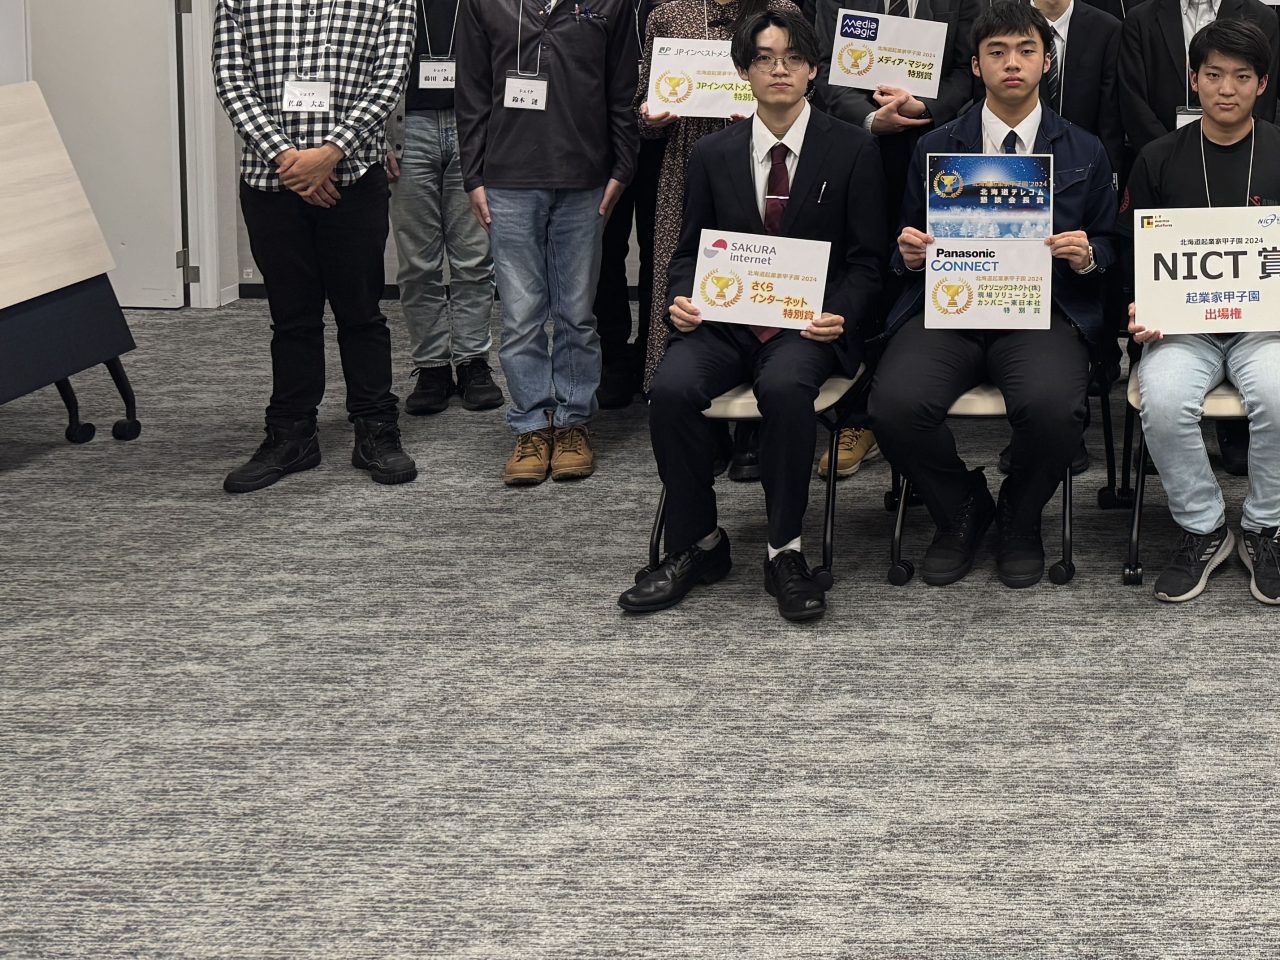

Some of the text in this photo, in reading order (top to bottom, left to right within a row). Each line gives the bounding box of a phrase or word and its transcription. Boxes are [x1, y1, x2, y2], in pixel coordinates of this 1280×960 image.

[843, 19, 877, 29] Media
[842, 26, 876, 38] Magic
[877, 56, 934, 70] メディア・マジック
[908, 70, 933, 80] 特別賞
[731, 242, 777, 255] SAKURA
[936, 248, 995, 258] Panasonic
[730, 253, 772, 265] internet
[931, 260, 999, 271] CONNECT
[1153, 250, 1248, 281] NICT
[751, 281, 774, 291] さくら
[750, 293, 808, 308] インターネット
[1185, 290, 1260, 304] 起業家甲子園
[783, 308, 815, 321] 特別賞
[1205, 308, 1242, 320] 出場権
